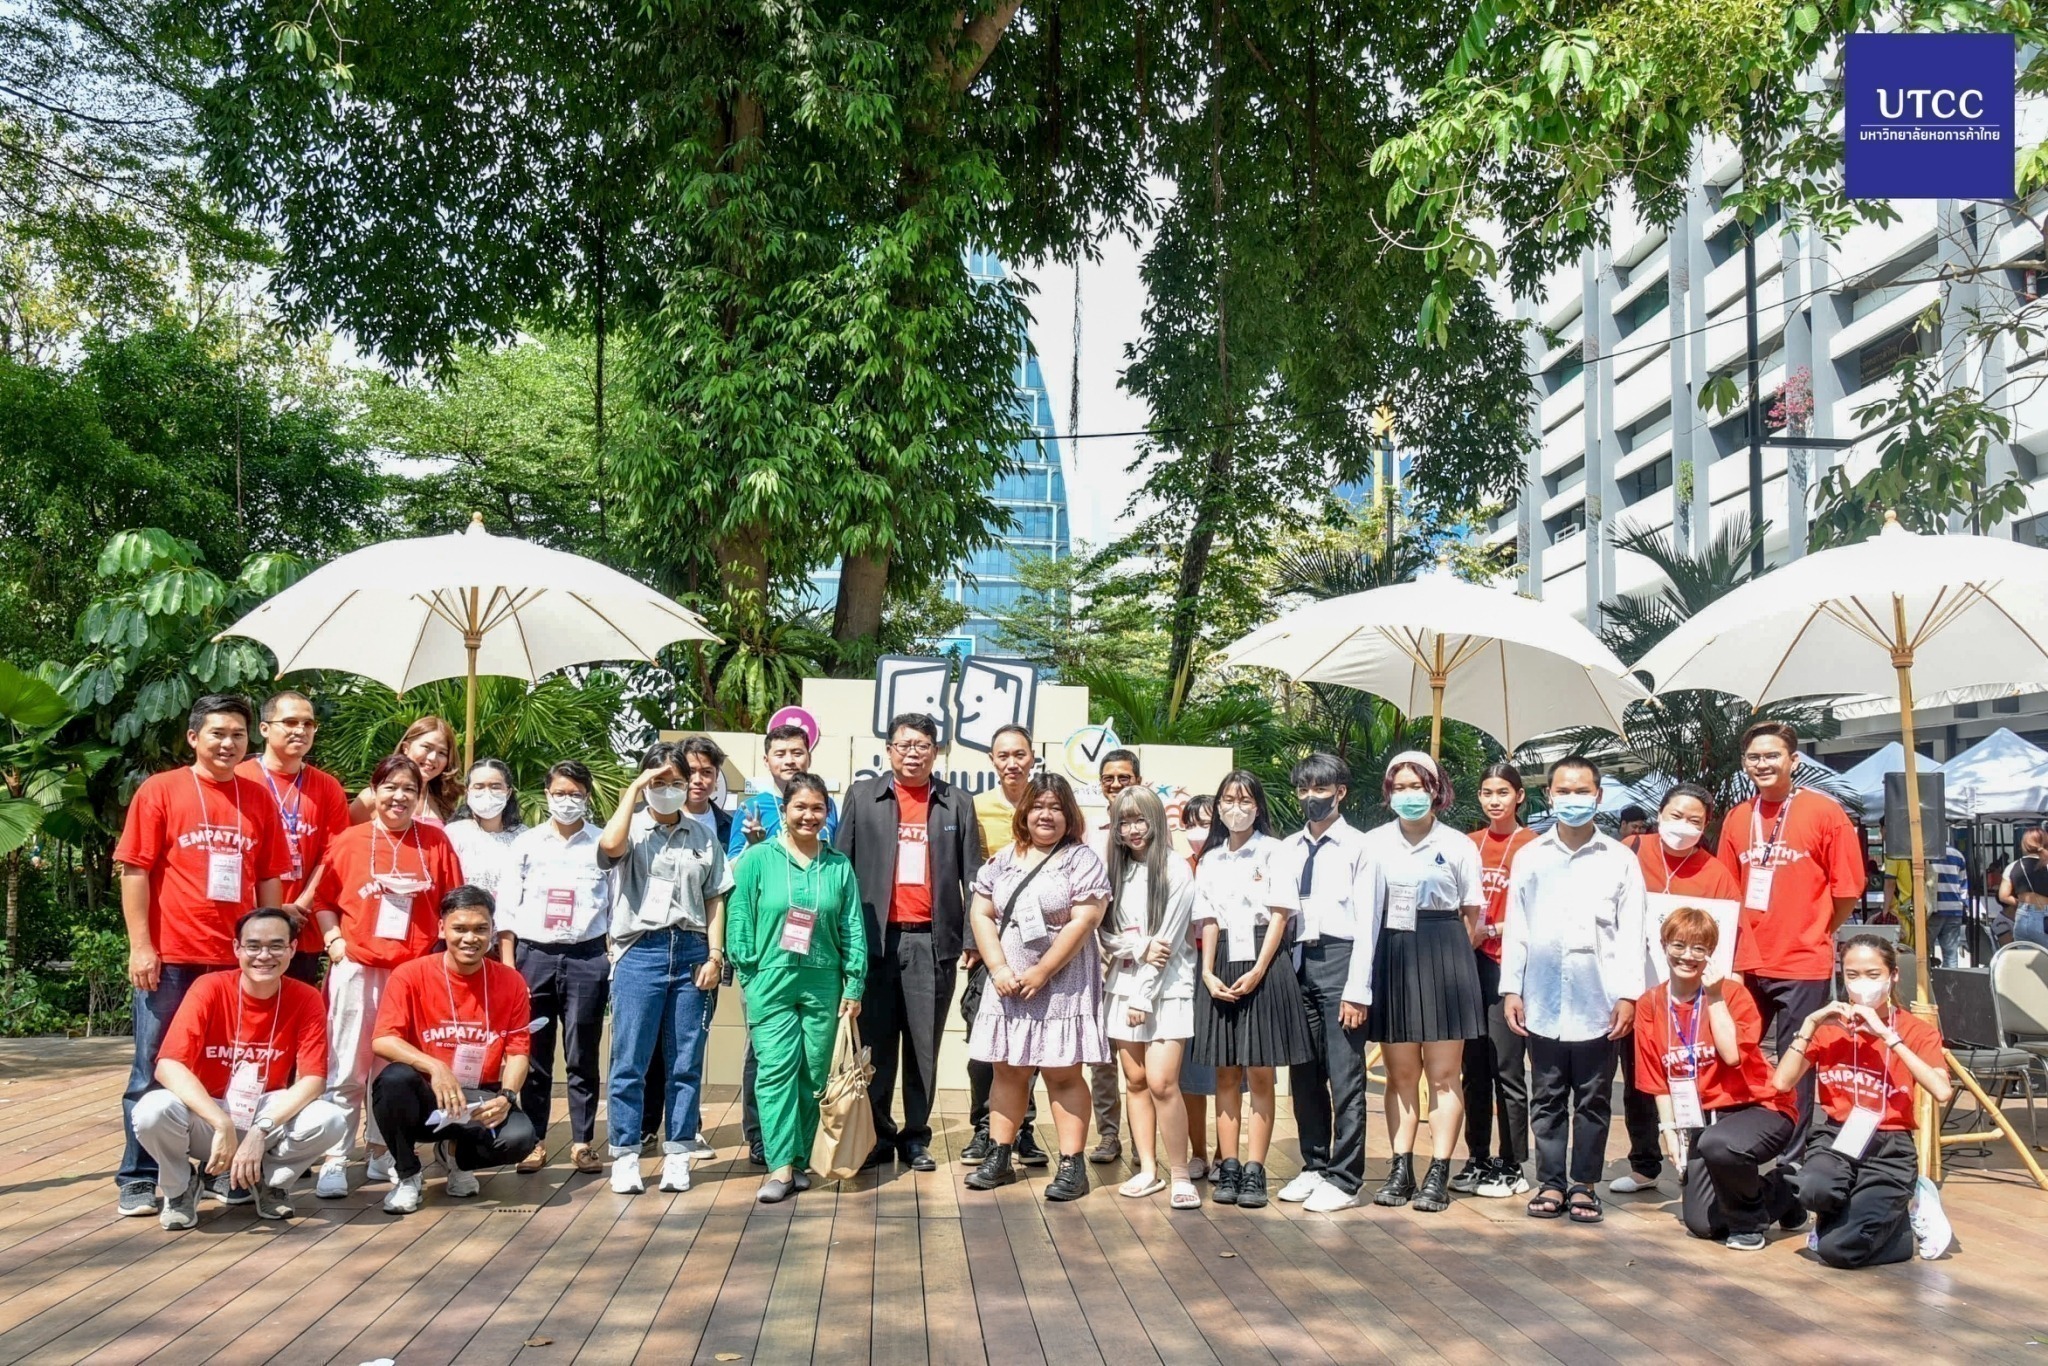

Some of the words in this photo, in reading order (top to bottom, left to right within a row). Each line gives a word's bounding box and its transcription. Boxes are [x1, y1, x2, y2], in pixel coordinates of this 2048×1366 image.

[178, 829, 254, 851] EMPATHY
[898, 826, 928, 841] PATH
[422, 1026, 499, 1044] EMPATHY
[206, 1046, 284, 1061] EMPATHY
[1819, 1070, 1898, 1098] EMPATHY
